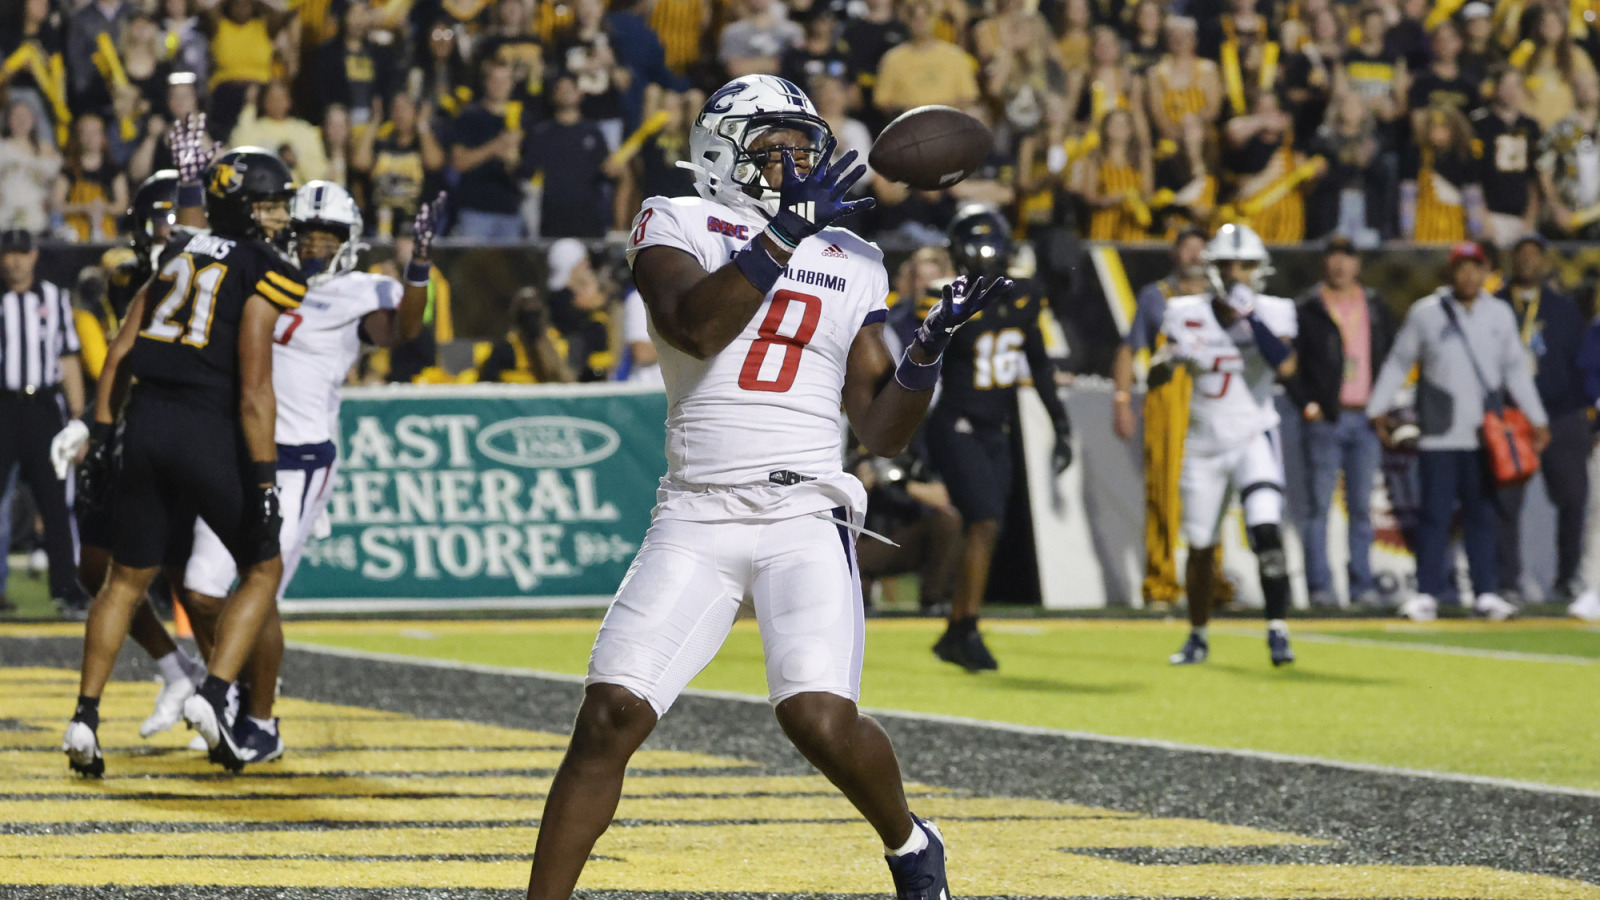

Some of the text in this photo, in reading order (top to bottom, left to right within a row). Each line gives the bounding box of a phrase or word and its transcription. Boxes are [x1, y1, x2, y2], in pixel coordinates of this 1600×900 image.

[633, 207, 653, 245] 8
[821, 251, 849, 260] adidas
[138, 252, 229, 349] 21
[738, 289, 822, 393] 8
[973, 327, 1027, 391] 16
[338, 414, 478, 469] AST
[359, 523, 582, 592] STORE
